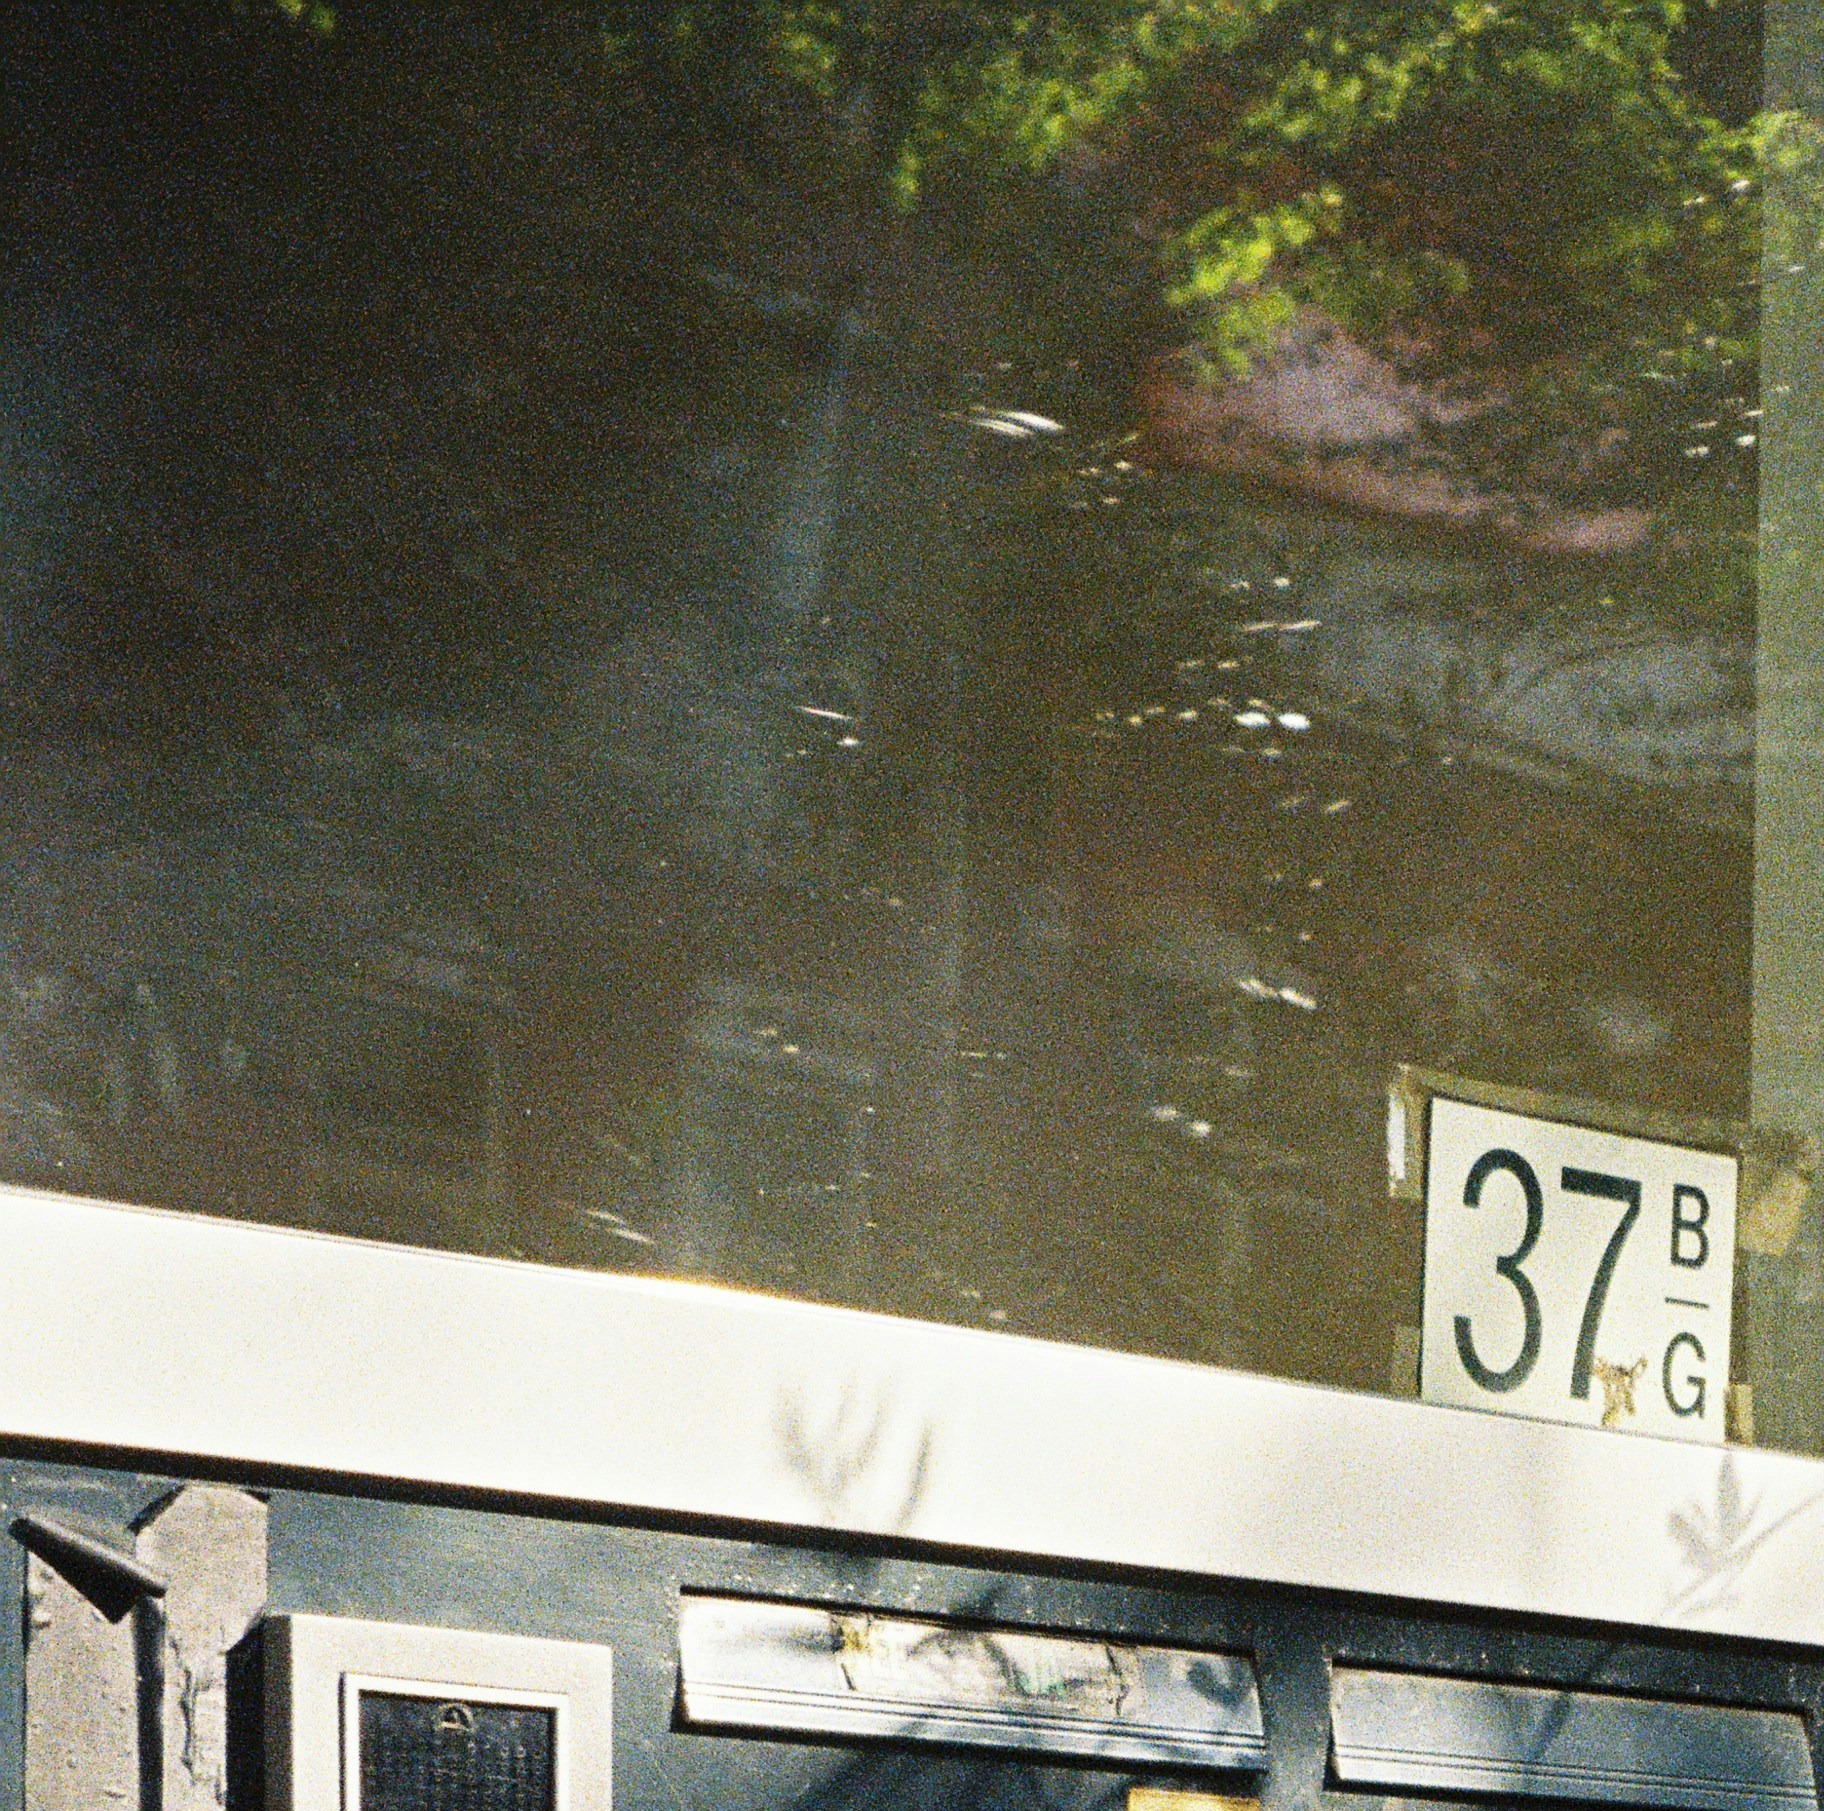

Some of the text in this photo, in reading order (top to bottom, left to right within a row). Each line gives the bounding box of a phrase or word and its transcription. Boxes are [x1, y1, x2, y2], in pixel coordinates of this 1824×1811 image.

[1453, 1148, 1710, 1401] 37 B
[1661, 1330, 1706, 1420] G
